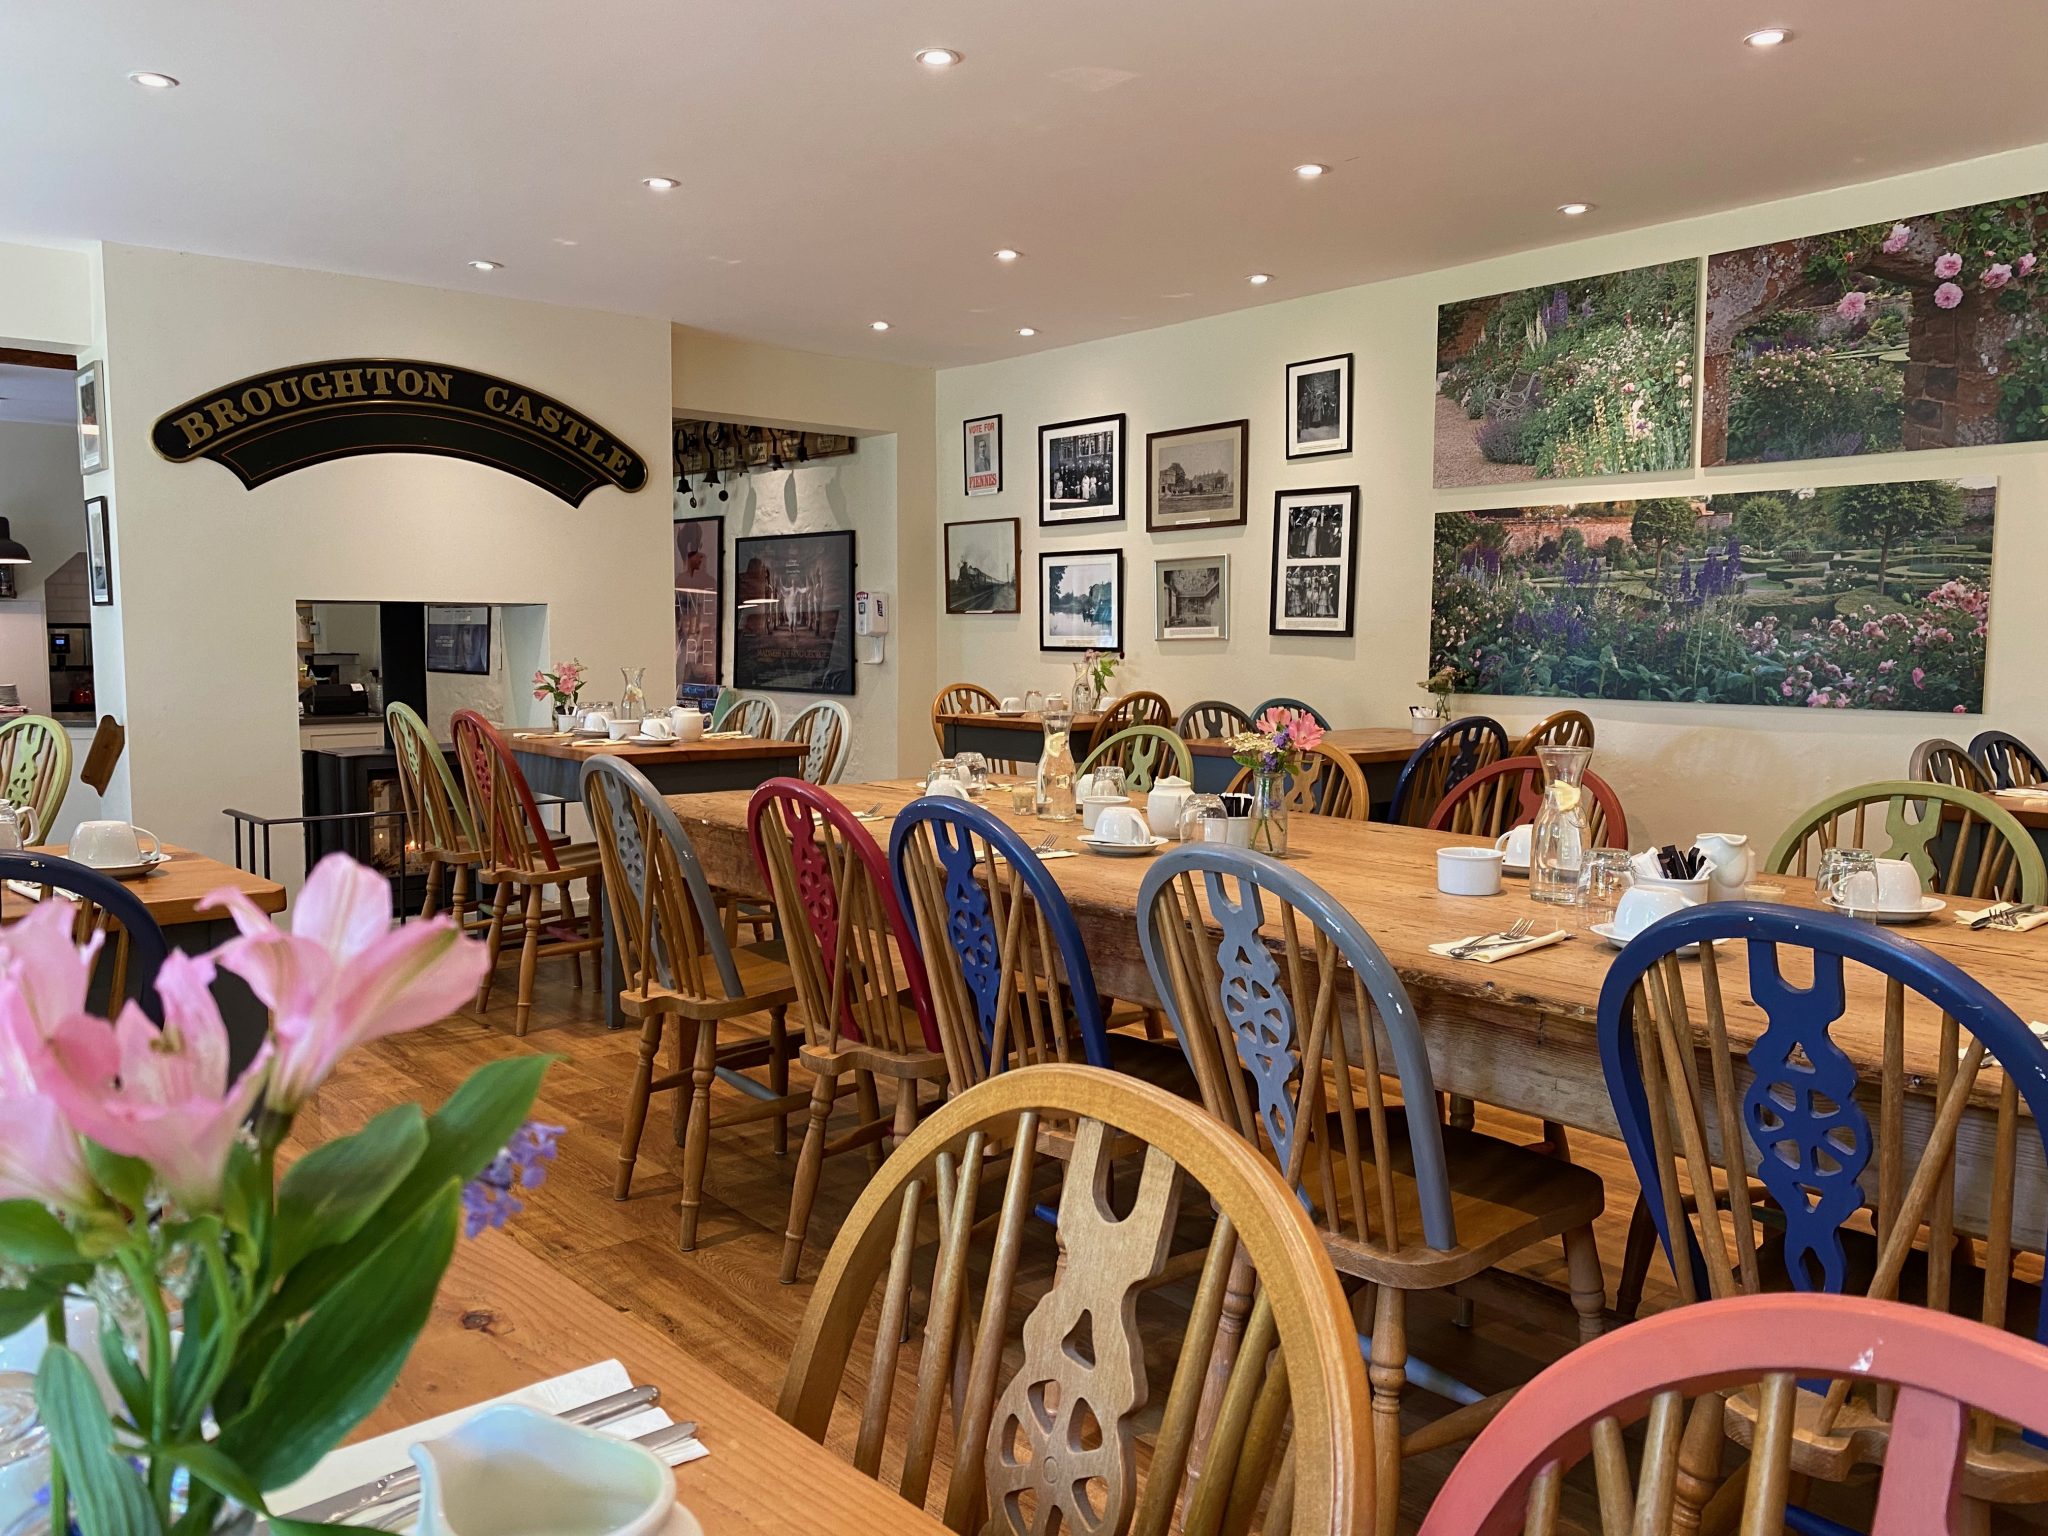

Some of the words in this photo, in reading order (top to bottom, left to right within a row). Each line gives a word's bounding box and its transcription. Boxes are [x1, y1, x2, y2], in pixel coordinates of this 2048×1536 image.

[172, 368, 454, 449] BROUGHTON
[483, 385, 635, 479] CASTLE
[968, 424, 983, 434] VOTE
[984, 422, 995, 432] FOR
[968, 473, 997, 489] FIENNES
